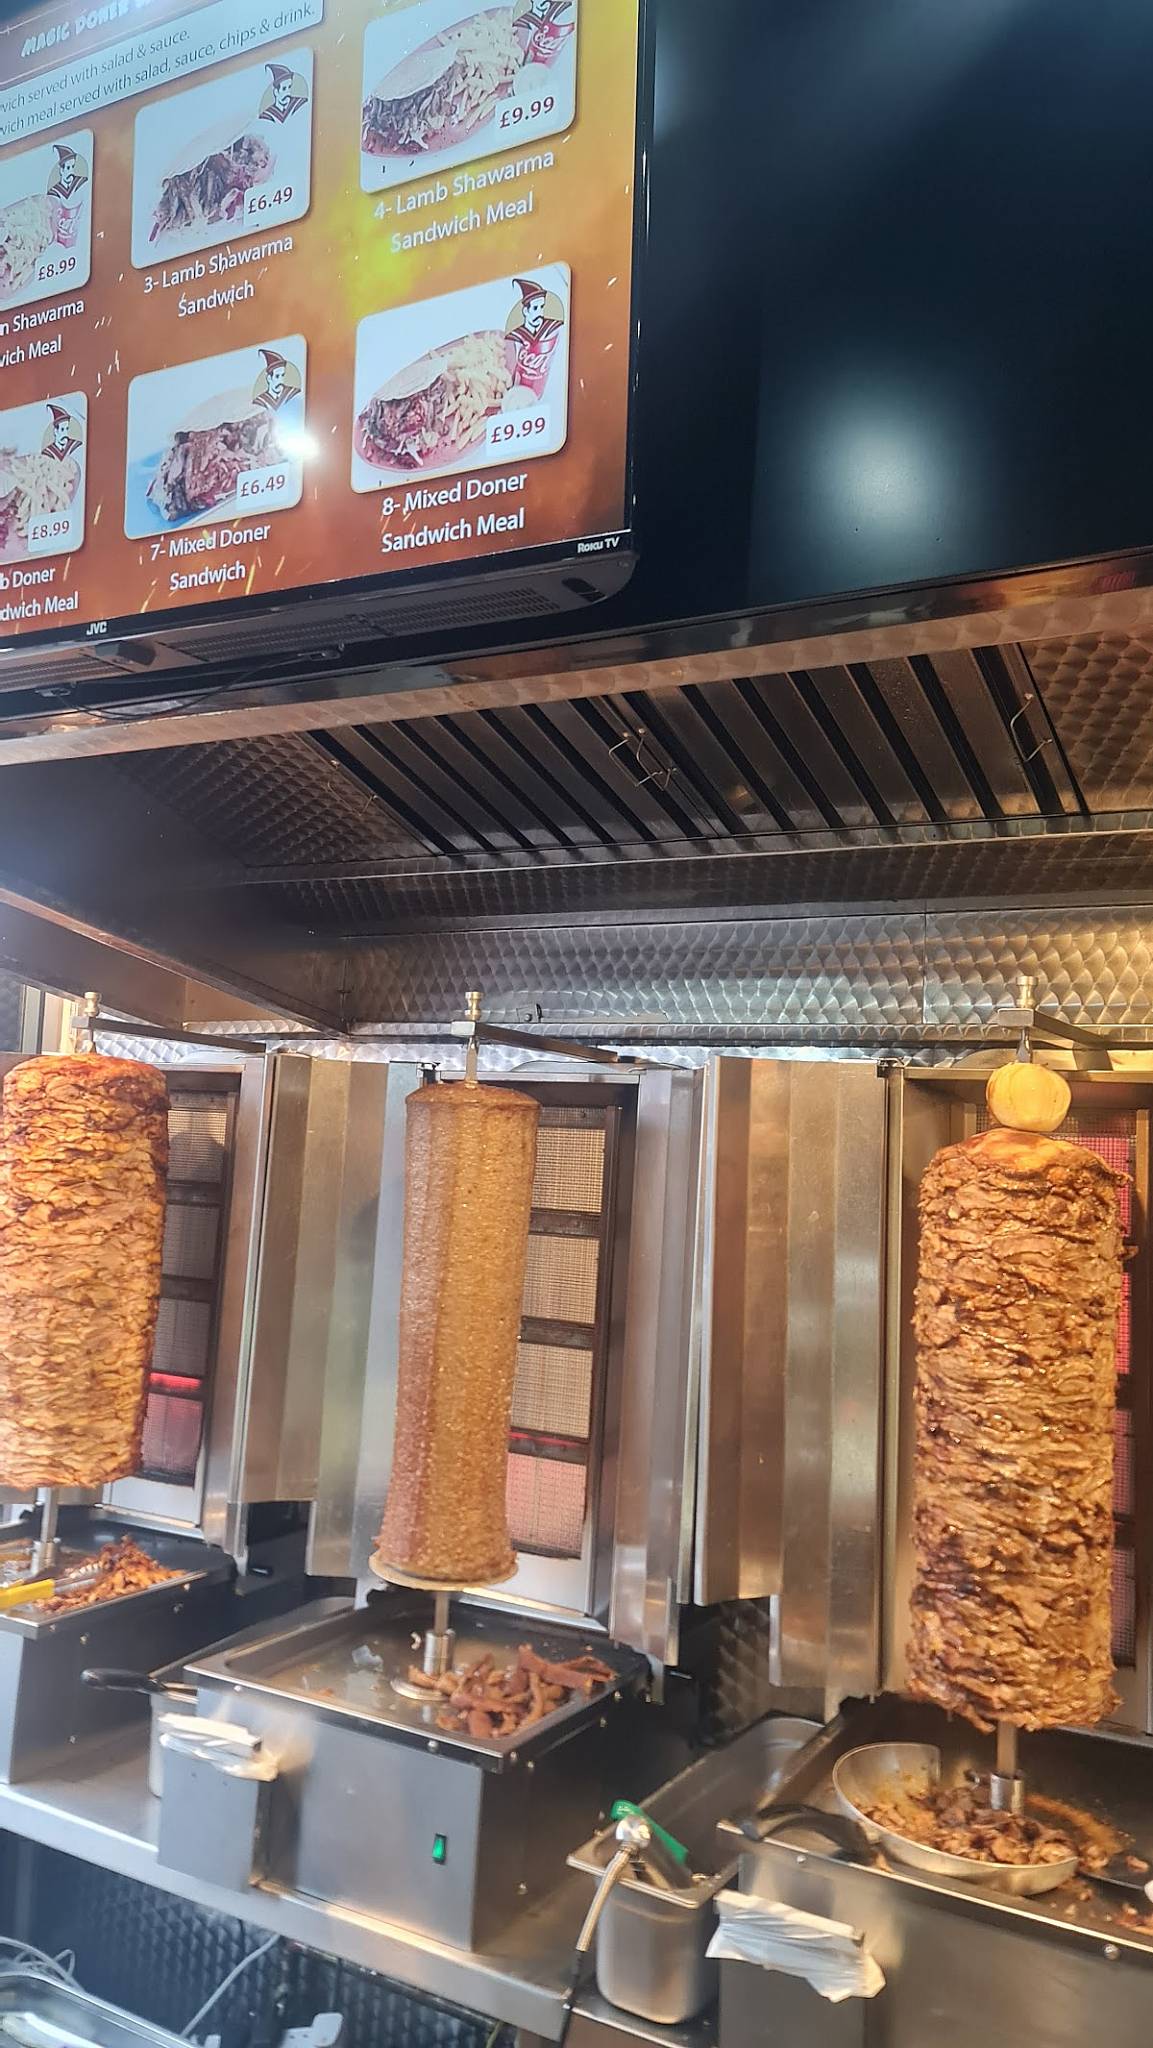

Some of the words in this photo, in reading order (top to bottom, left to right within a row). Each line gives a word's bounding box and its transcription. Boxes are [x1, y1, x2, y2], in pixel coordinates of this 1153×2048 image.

[27, 102, 57, 126] meal
[60, 85, 100, 114] served
[103, 71, 132, 95] with
[135, 56, 171, 86] salad,
[175, 43, 216, 67] sauce,
[219, 26, 256, 51] chips
[259, 17, 271, 34] &
[274, 5, 315, 29] drink.
[28, 75, 68, 103] served
[71, 64, 98, 85] with
[101, 45, 134, 74] salad
[136, 43, 147, 59] &
[150, 29, 190, 54] sauce.
[499, 96, 555, 129] £9.99
[247, 187, 293, 214] £6.49
[373, 200, 392, 220] 4-
[396, 181, 448, 215] Lamb
[452, 151, 554, 196] Shawarma
[390, 211, 481, 253] Sandwich
[486, 191, 534, 225] Meal
[38, 257, 76, 281] £8.99
[143, 277, 159, 293] 3-
[162, 260, 206, 288] Lamb
[208, 236, 293, 273] Shawarma
[177, 281, 255, 317] Sandwich
[12, 300, 85, 332] Shawarma
[28, 334, 61, 360] Meal
[491, 417, 546, 443] £9.99
[240, 473, 286, 498] £6.49
[381, 497, 400, 516] 8-
[404, 479, 461, 511] Mixed
[466, 472, 528, 499] Doner
[31, 520, 70, 541] £8.99
[150, 543, 166, 561] 7-
[168, 532, 217, 559] Mixed
[219, 524, 271, 550] Doner
[381, 519, 472, 553] Sandwich
[477, 508, 525, 536] Meal
[604, 536, 620, 549] TV
[12, 567, 56, 588] Doner
[169, 561, 246, 591] Sandwich
[44, 590, 79, 615] Meal
[86, 621, 107, 636] JVC
